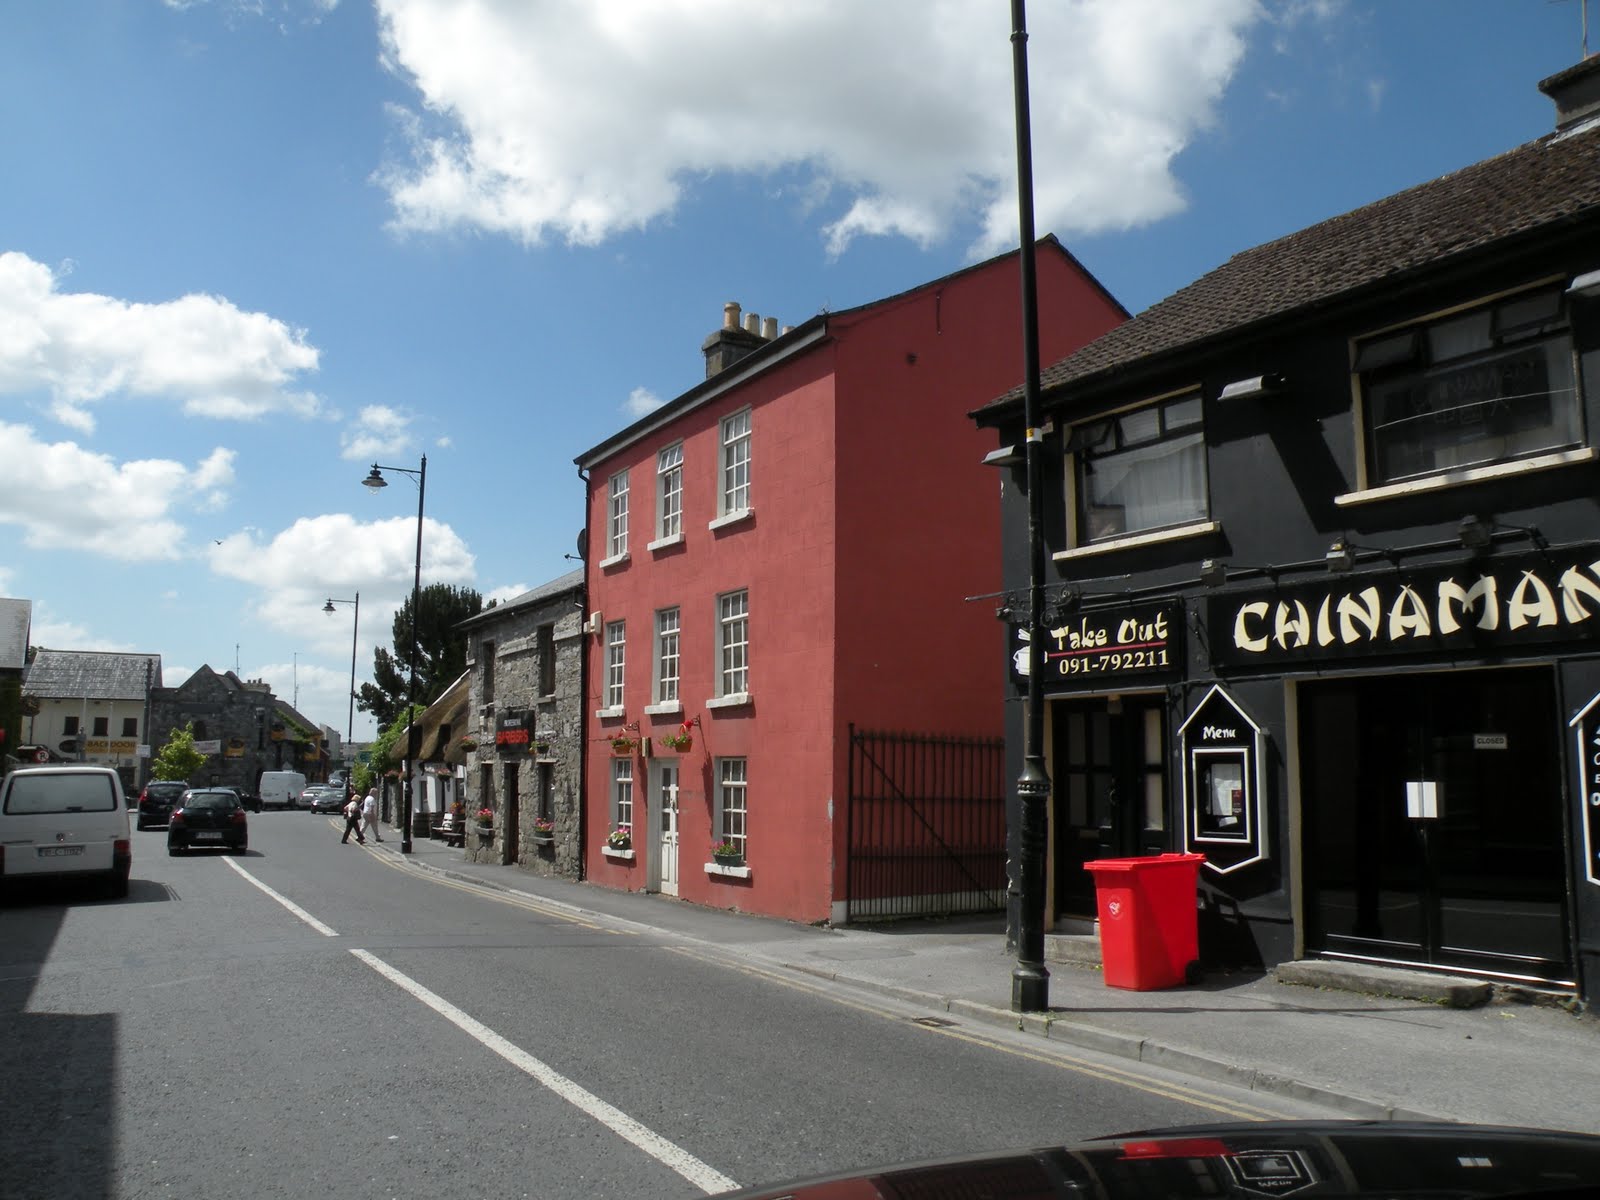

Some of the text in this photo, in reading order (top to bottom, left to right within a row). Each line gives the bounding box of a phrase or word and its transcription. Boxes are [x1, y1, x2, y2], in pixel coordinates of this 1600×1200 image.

[1234, 561, 1600, 652] CHINAMAN
[1050, 611, 1168, 650] Take Out
[1059, 649, 1169, 675] 091-792211
[1203, 725, 1236, 739] Menu
[1476, 737, 1505, 745] CLOSED
